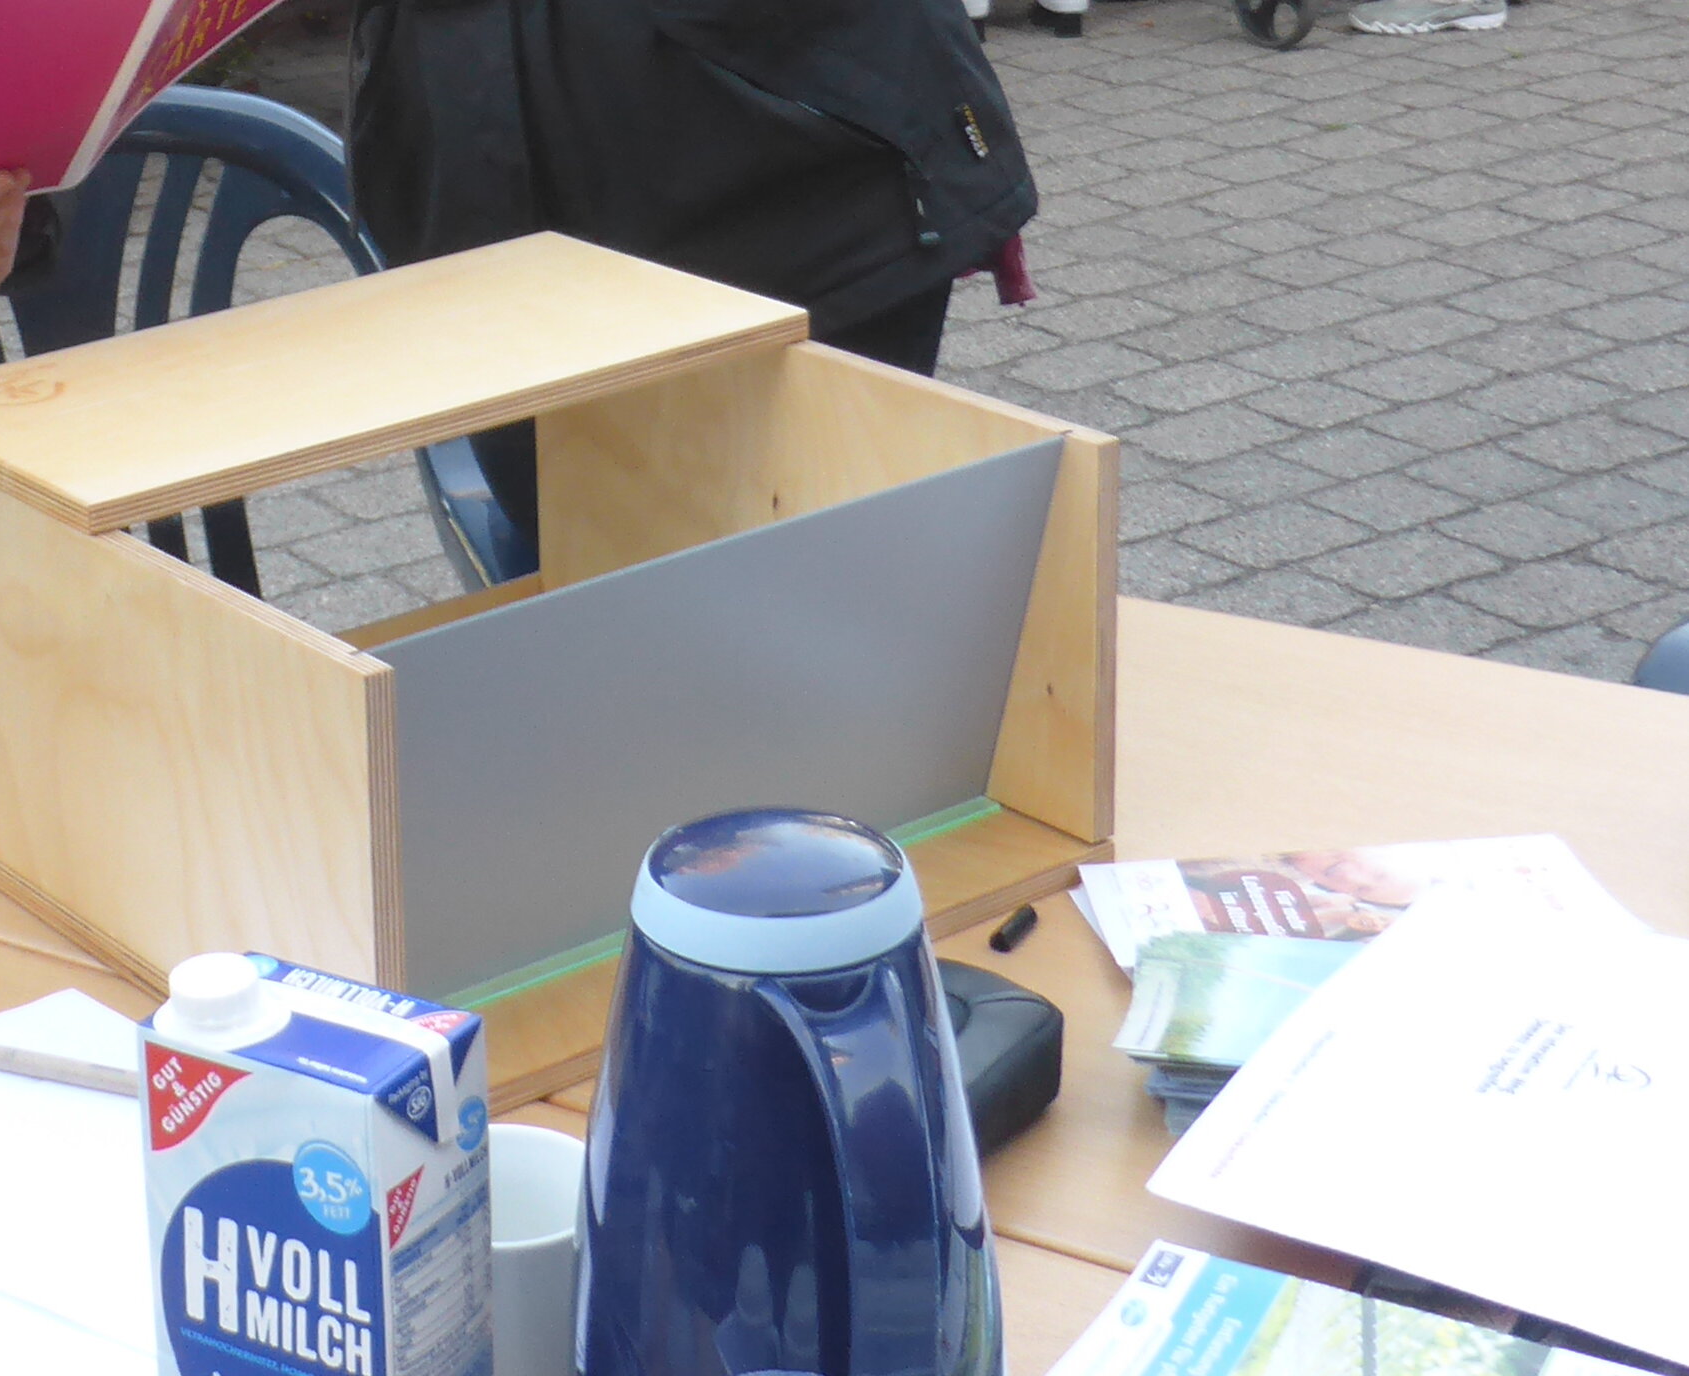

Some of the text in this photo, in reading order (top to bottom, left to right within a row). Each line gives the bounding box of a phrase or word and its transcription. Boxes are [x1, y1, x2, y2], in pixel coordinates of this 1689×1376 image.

[152, 1056, 183, 1090] GUT
[161, 1071, 223, 1134] GÜNSTIG
[171, 1080, 187, 1098] &
[298, 1167, 364, 1204] 3,5%
[183, 1205, 239, 1334] H
[246, 1224, 372, 1324] VOLL
[246, 1288, 373, 1376] MILCH
